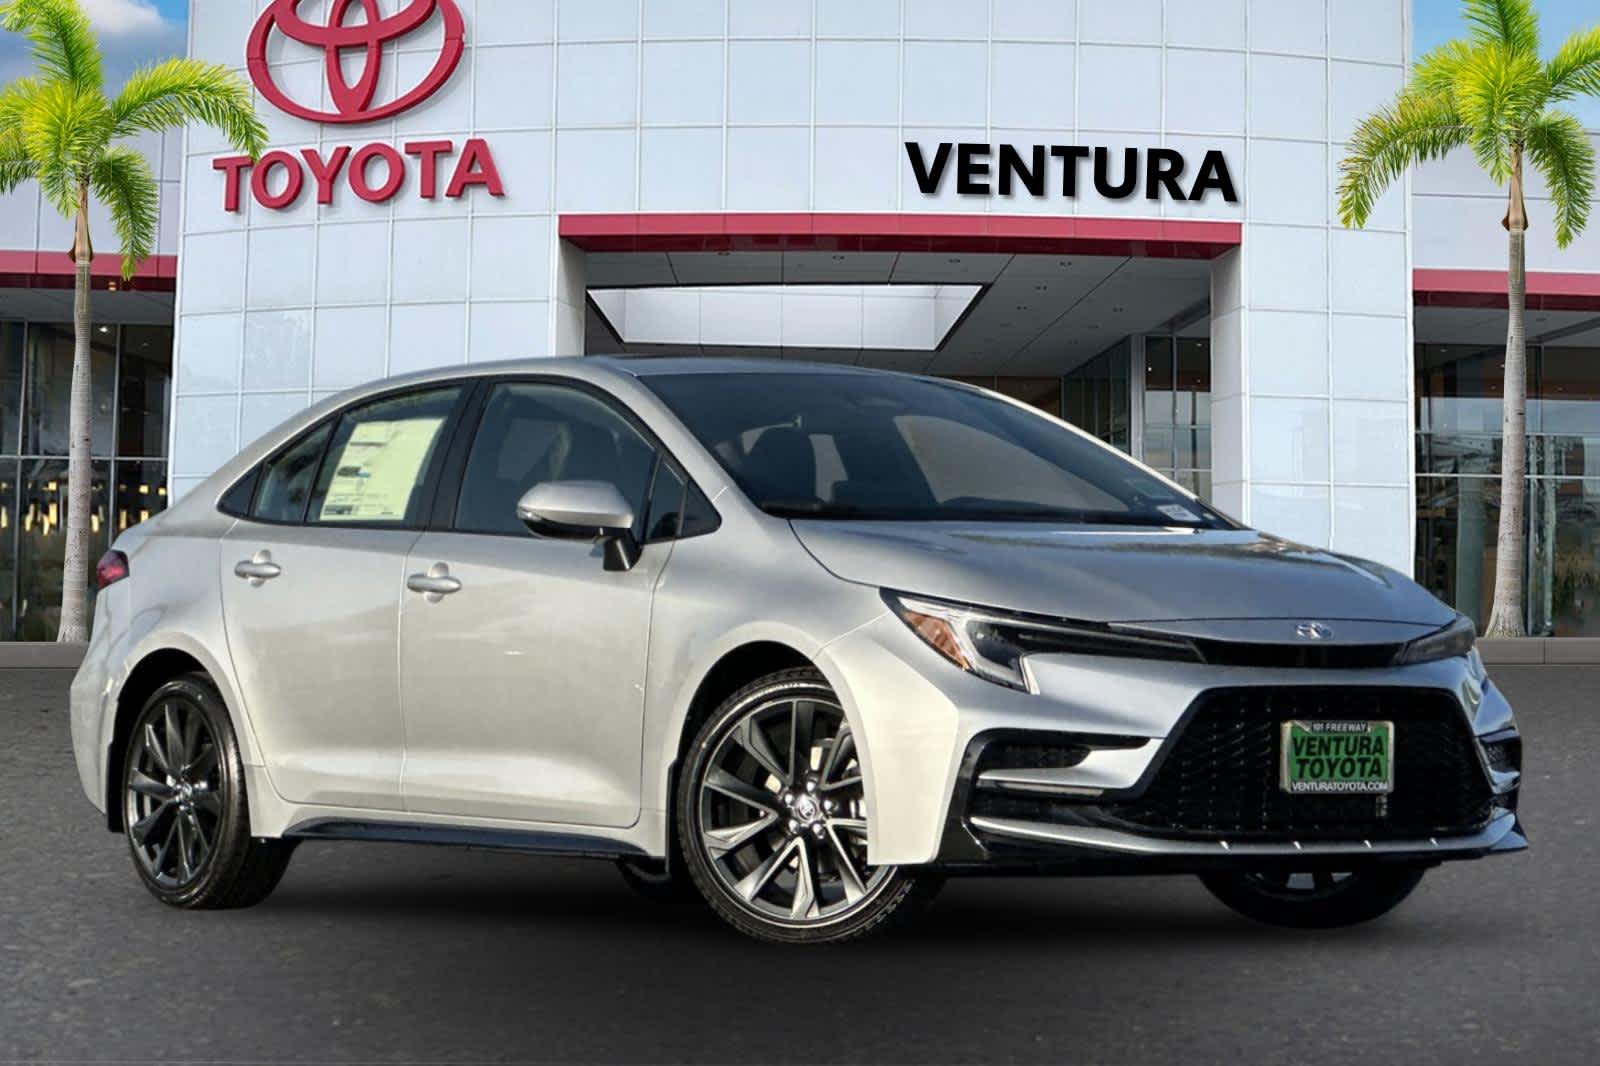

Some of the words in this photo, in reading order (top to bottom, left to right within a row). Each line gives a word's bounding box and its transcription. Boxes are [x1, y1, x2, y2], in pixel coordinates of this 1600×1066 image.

[212, 138, 505, 212] TOYOTA
[904, 142, 1238, 203] VENTURA
[1325, 723, 1366, 732] FREEWAY
[1293, 735, 1384, 756] VENTURA
[1296, 758, 1382, 778] TOYOTA
[1292, 782, 1388, 791] VENTURATOYOTA.COM
